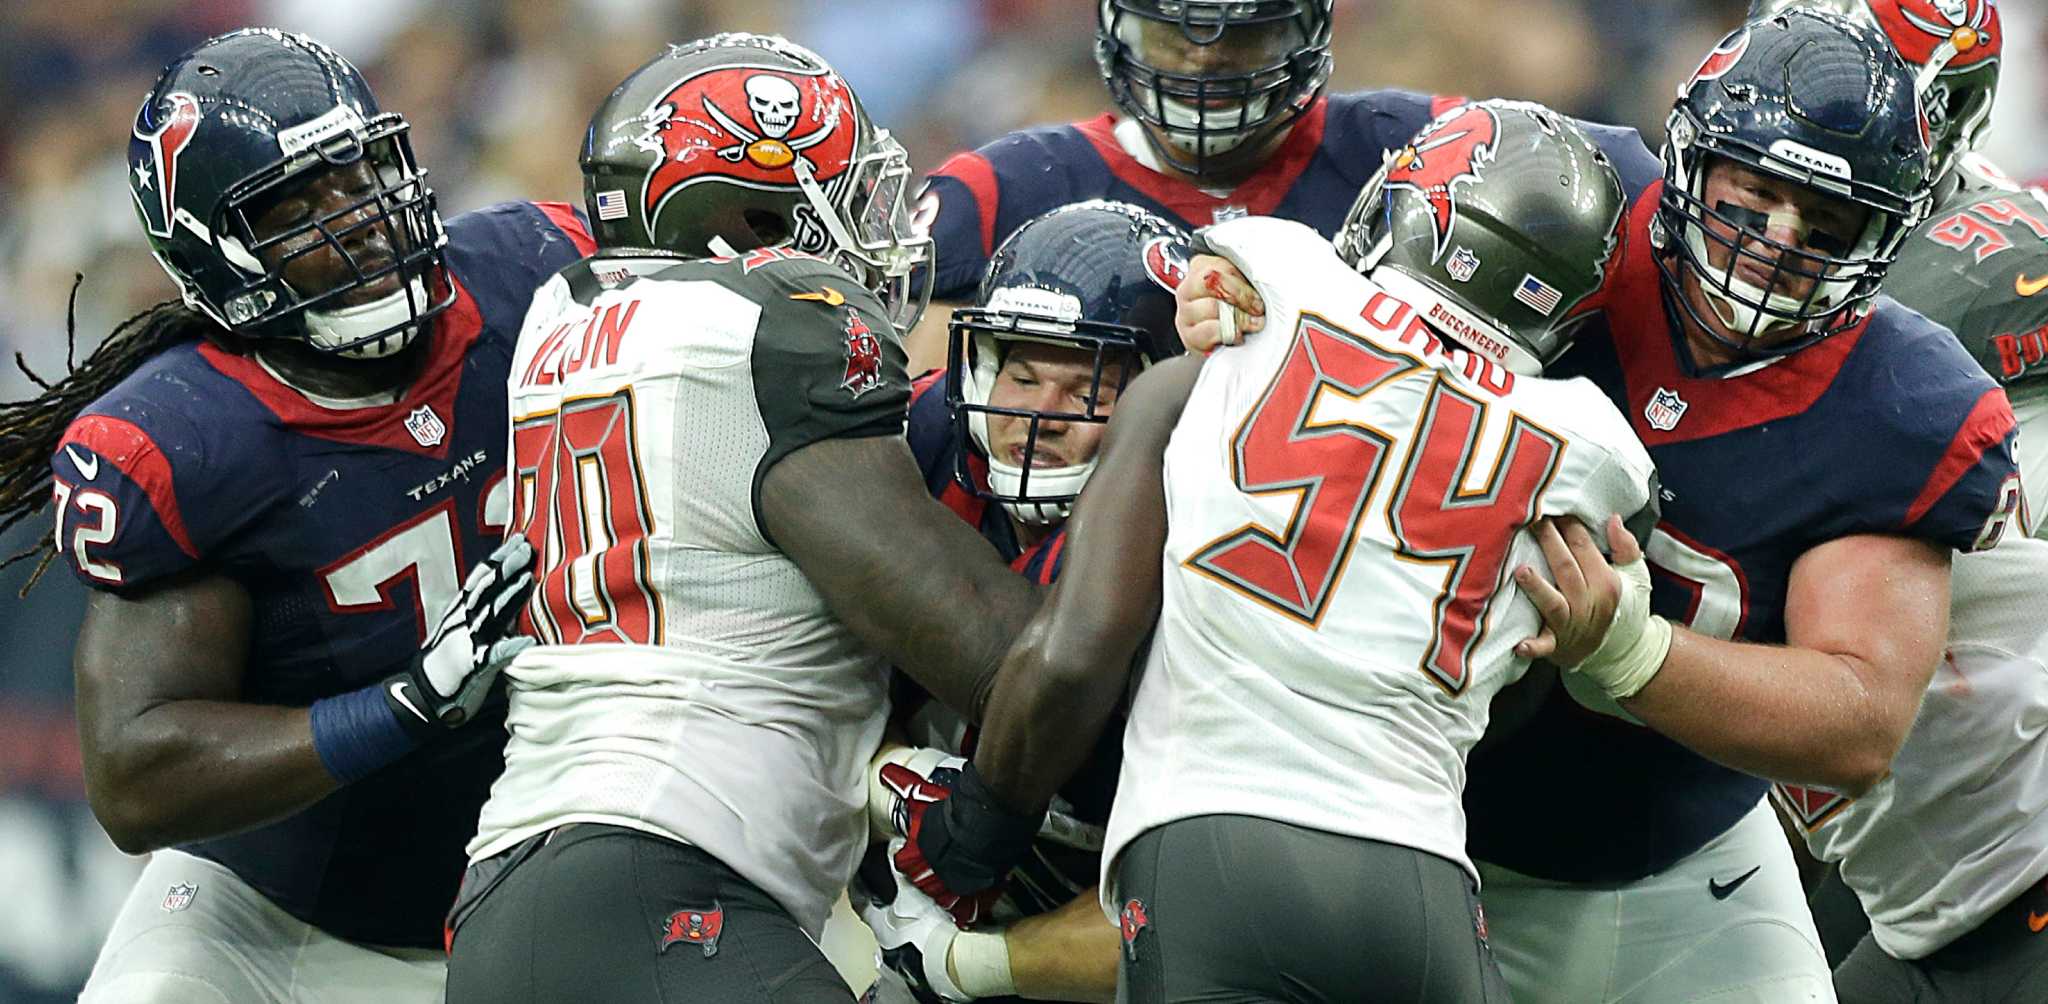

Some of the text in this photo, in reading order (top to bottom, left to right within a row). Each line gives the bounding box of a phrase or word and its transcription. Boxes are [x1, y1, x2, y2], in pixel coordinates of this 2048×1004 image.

[1783, 149, 1842, 174] TEXANS
[1925, 198, 2048, 265] 94
[1450, 257, 1471, 279] NFL
[1428, 303, 1511, 360] BUCCANEERS
[417, 420, 440, 442] NFL
[1650, 402, 1674, 425] NFL
[406, 450, 487, 501] TEXANS
[52, 474, 126, 585] 72
[1181, 310, 1568, 698] 54
